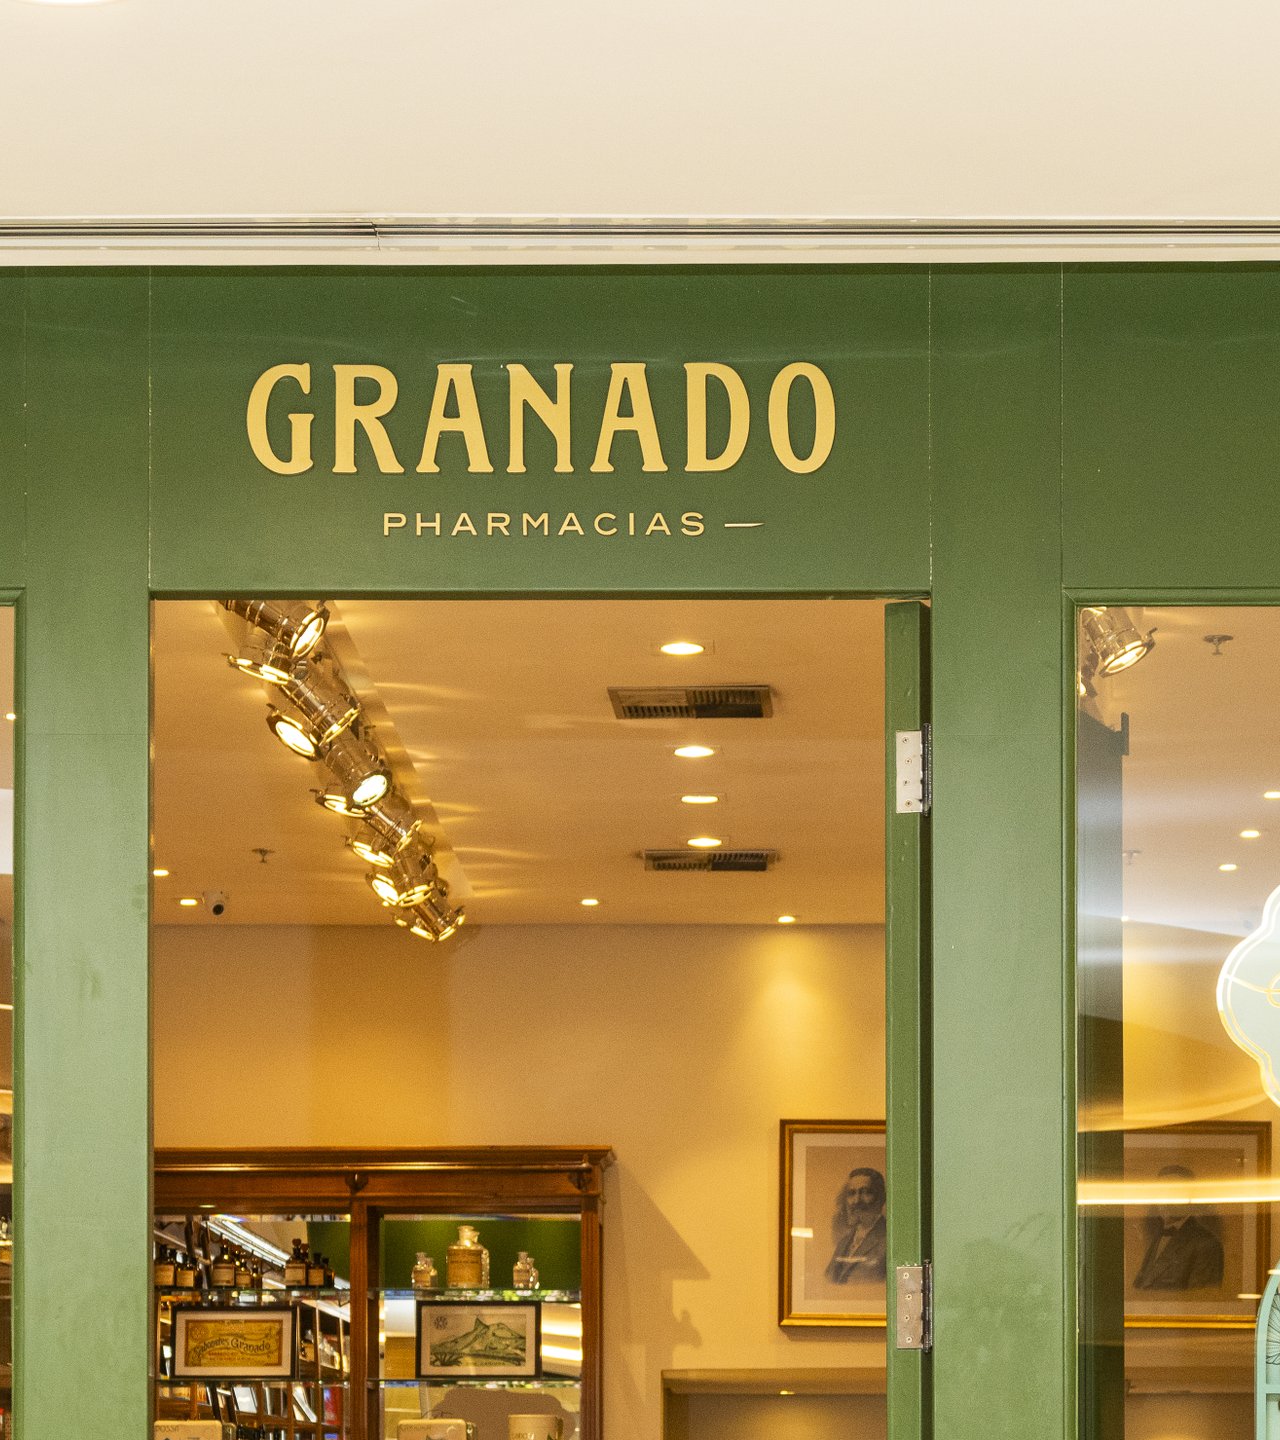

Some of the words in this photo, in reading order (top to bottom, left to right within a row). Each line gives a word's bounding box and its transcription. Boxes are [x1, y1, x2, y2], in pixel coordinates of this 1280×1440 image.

[246, 361, 836, 475] GRANADO
[382, 511, 706, 537] PHARMACIAS
[231, 1337, 271, 1353] Granado
